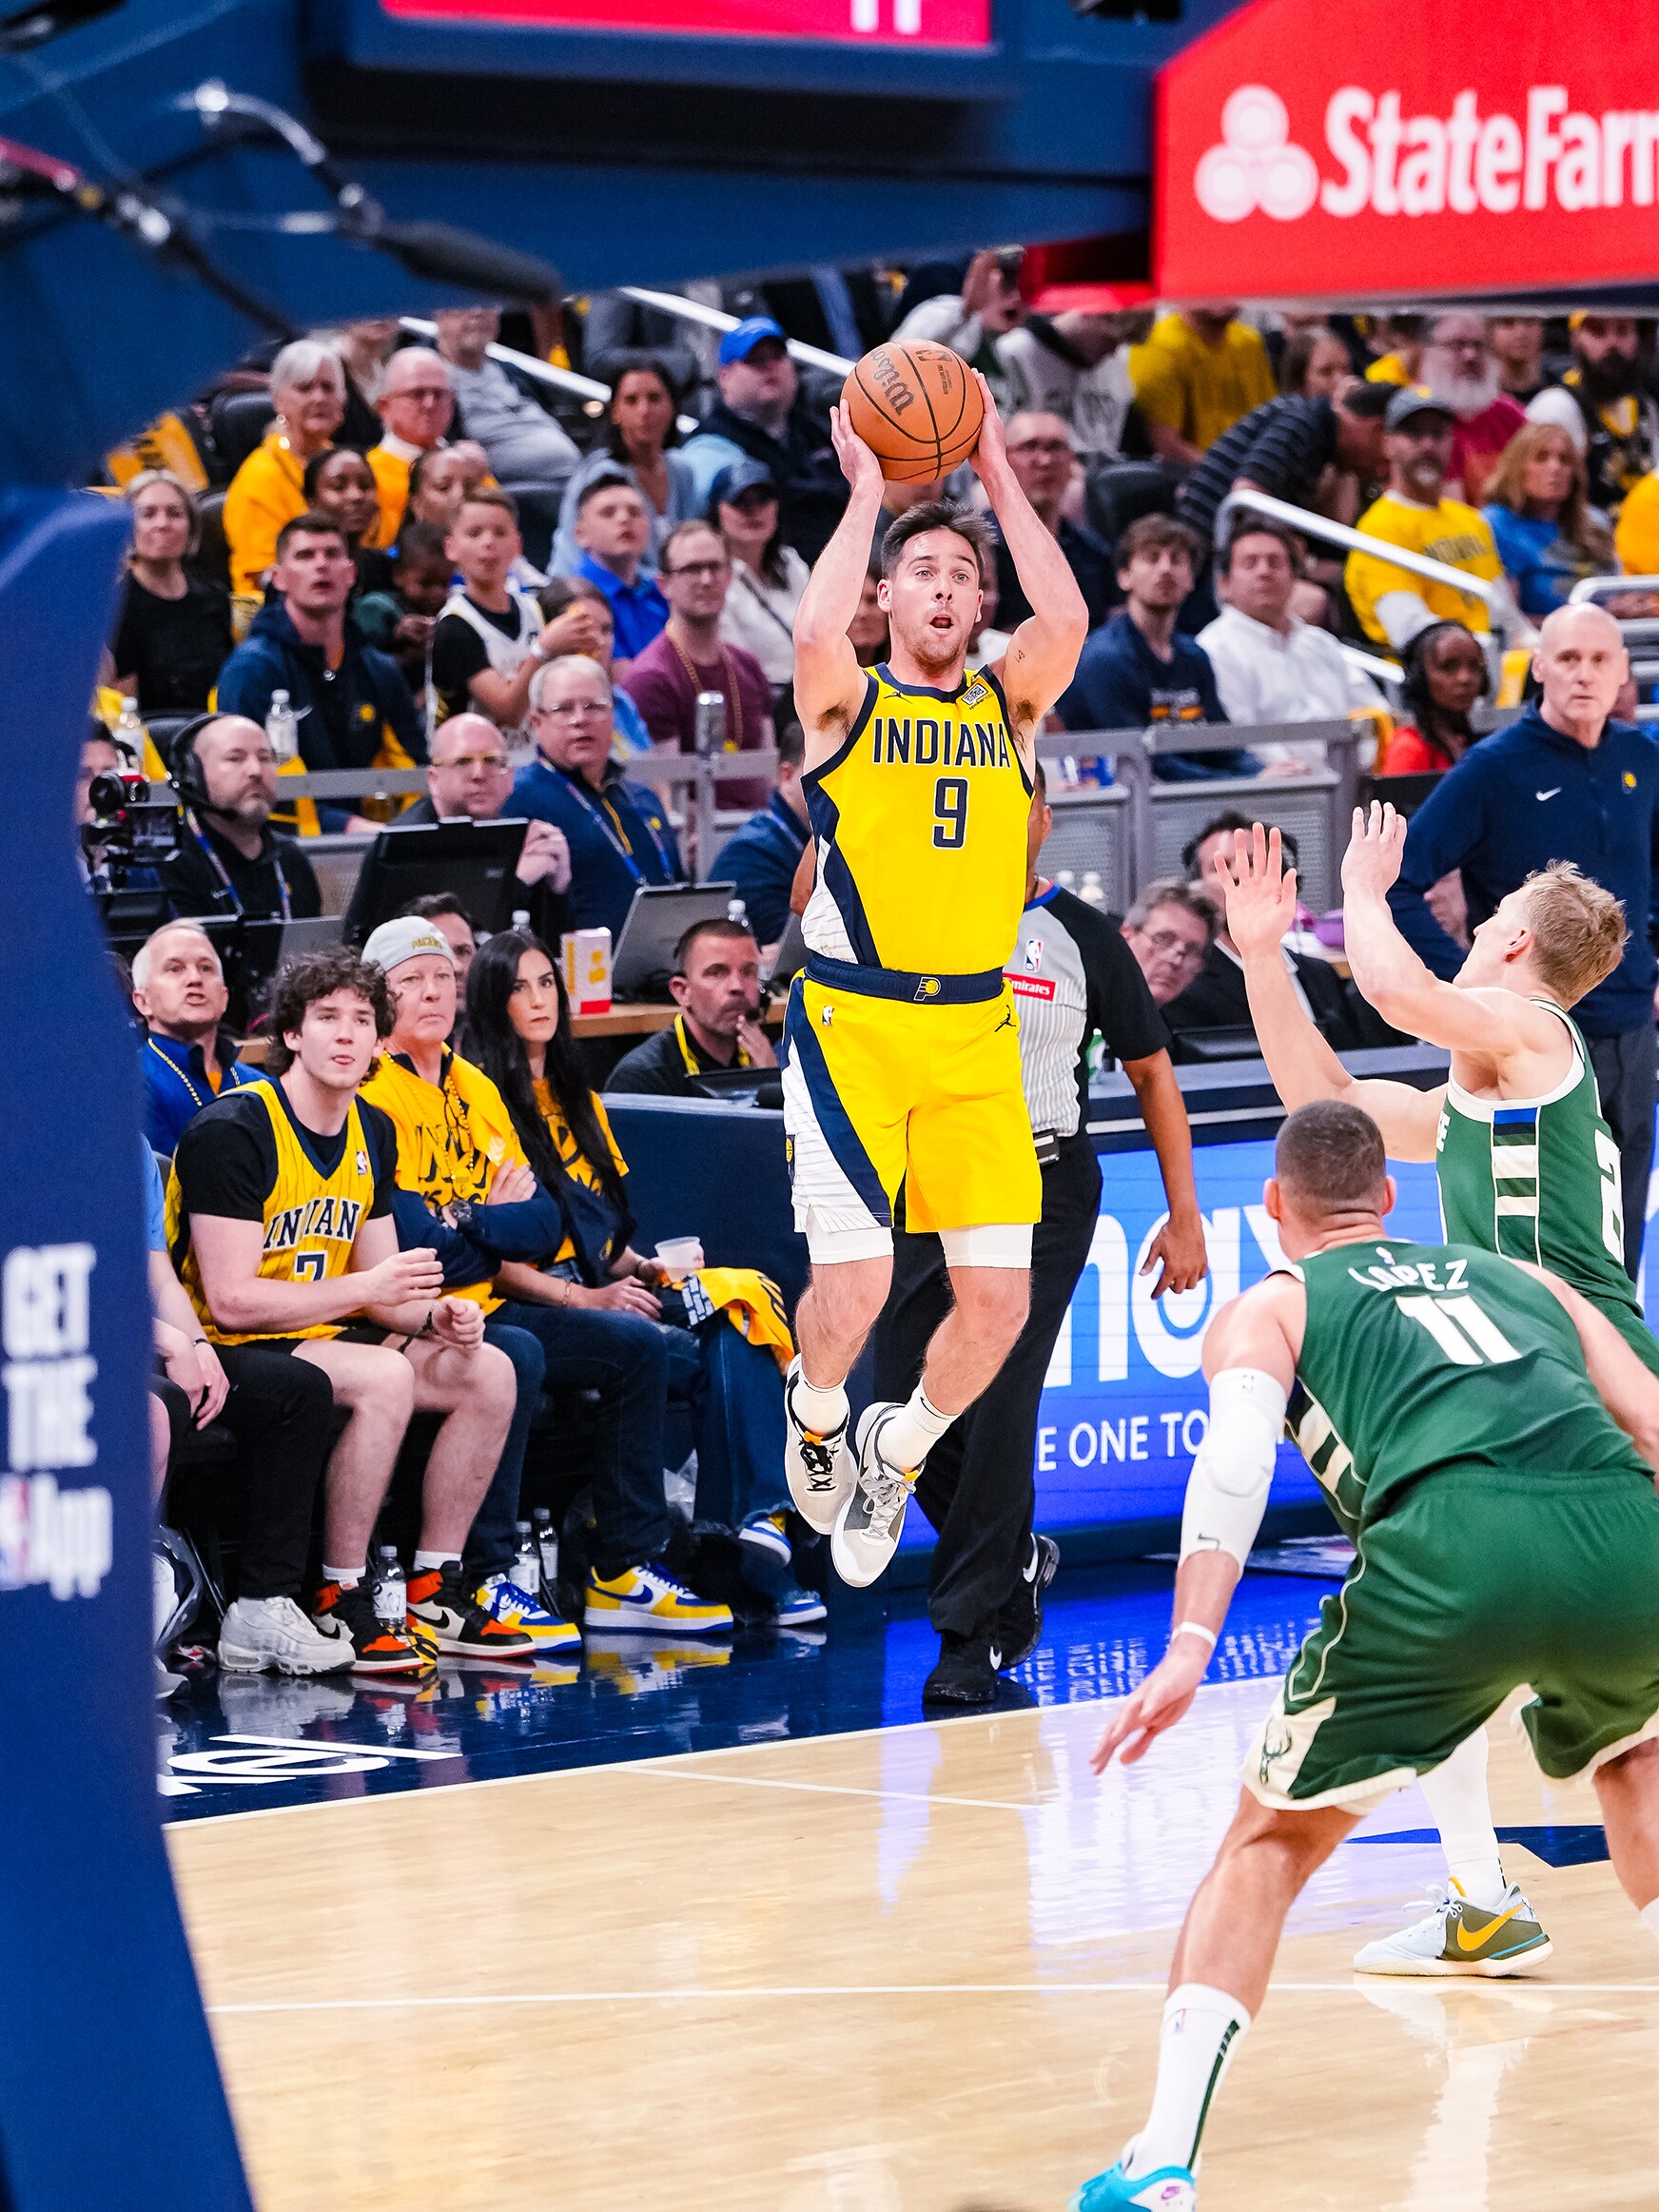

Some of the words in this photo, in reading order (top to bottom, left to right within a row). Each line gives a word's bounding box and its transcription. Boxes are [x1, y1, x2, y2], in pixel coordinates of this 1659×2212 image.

[870, 347, 915, 417] Wilso
[873, 718, 1011, 769] INDIANA
[932, 777, 969, 850] 9
[1010, 979, 1050, 995] mirates
[1347, 1259, 1469, 1292] LOPEZ
[1395, 1295, 1523, 1365] 11
[1068, 1416, 1149, 1468] ONE
[1160, 1409, 1211, 1458] TO
